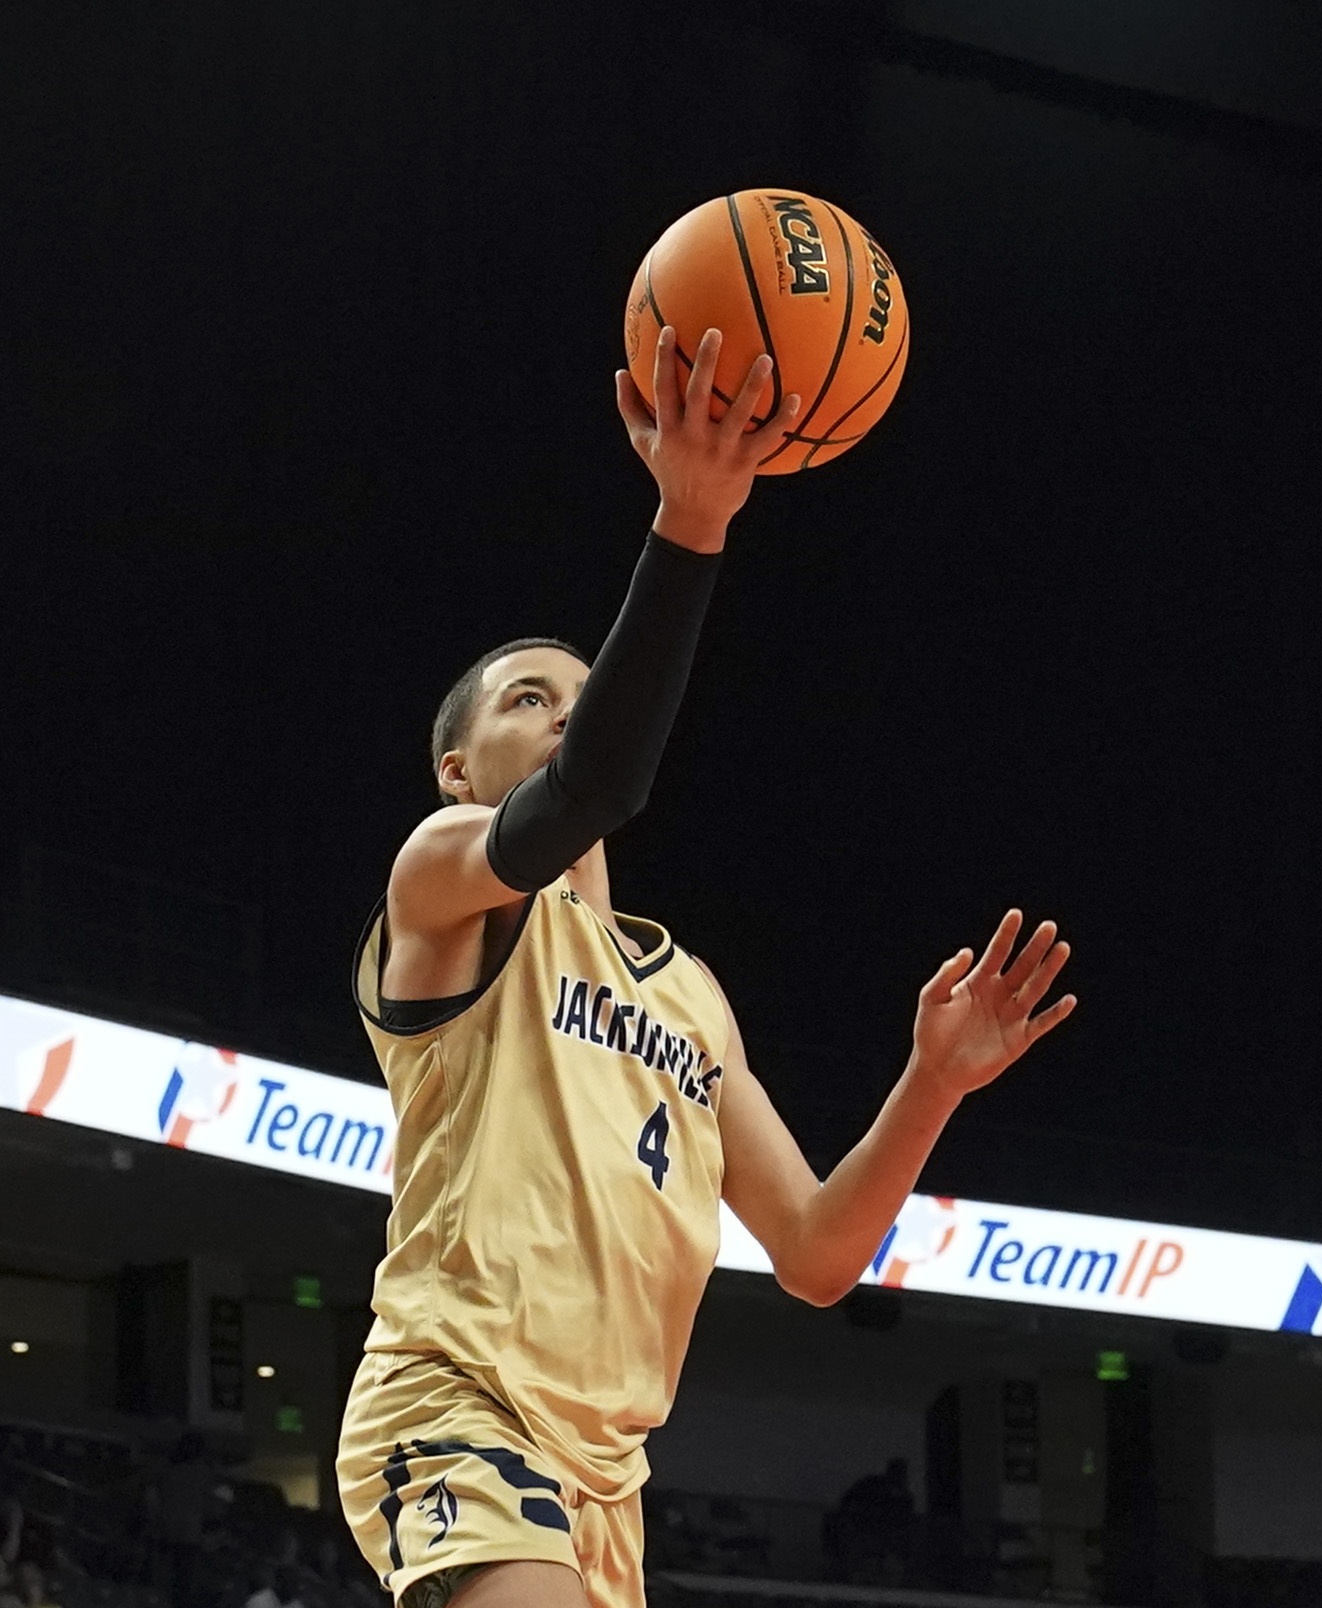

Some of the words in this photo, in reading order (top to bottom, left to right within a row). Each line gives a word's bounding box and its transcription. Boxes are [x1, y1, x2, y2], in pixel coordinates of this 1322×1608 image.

[766, 195, 830, 296] NCAA
[636, 1100, 671, 1192] 4
[967, 1218, 1184, 1299] TeamIP
